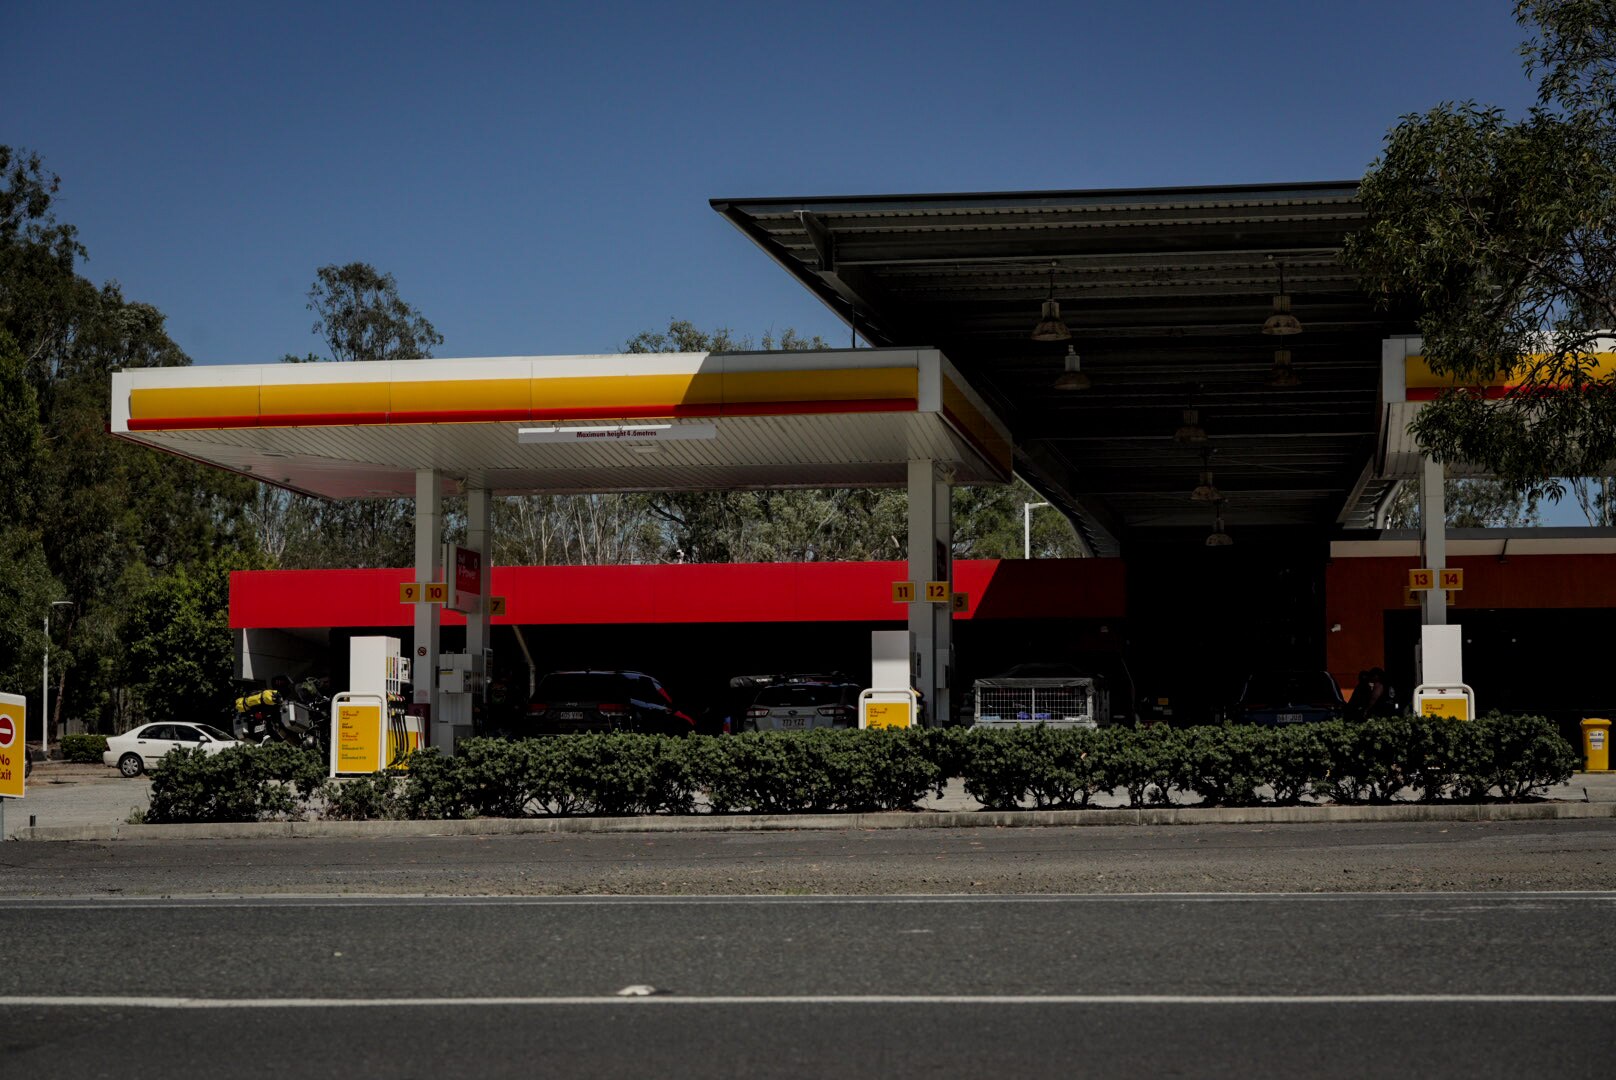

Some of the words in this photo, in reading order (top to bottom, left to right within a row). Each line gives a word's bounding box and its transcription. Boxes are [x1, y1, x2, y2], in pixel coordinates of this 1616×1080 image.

[607, 430, 626, 439] height
[1414, 573, 1428, 585] 13
[1444, 573, 1458, 585] 14
[405, 587, 413, 598] 9
[429, 587, 442, 598] 10
[897, 586, 908, 598] 11
[929, 585, 944, 597] 12
[492, 600, 501, 611] 7
[955, 597, 963, 608] 5
